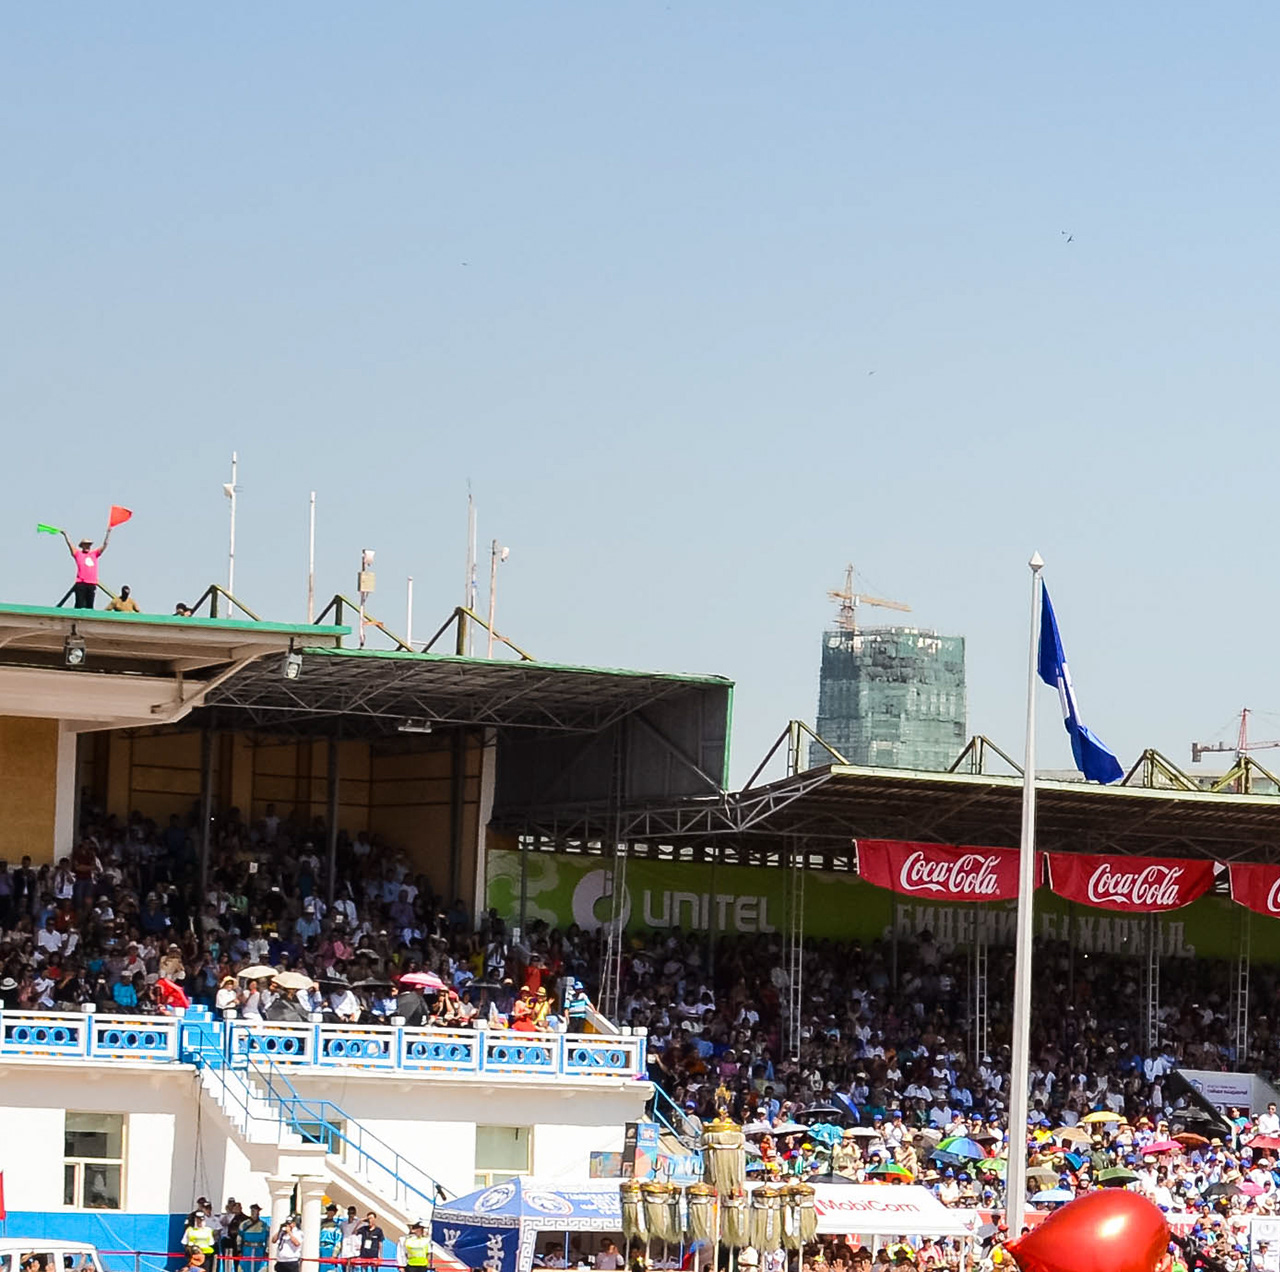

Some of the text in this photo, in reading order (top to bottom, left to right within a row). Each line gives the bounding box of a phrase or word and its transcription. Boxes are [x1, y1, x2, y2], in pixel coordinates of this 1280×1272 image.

[900, 852, 998, 893] Coca-Cola
[1088, 864, 1183, 904] Coca-Cola
[818, 1199, 920, 1213] MobiCom
